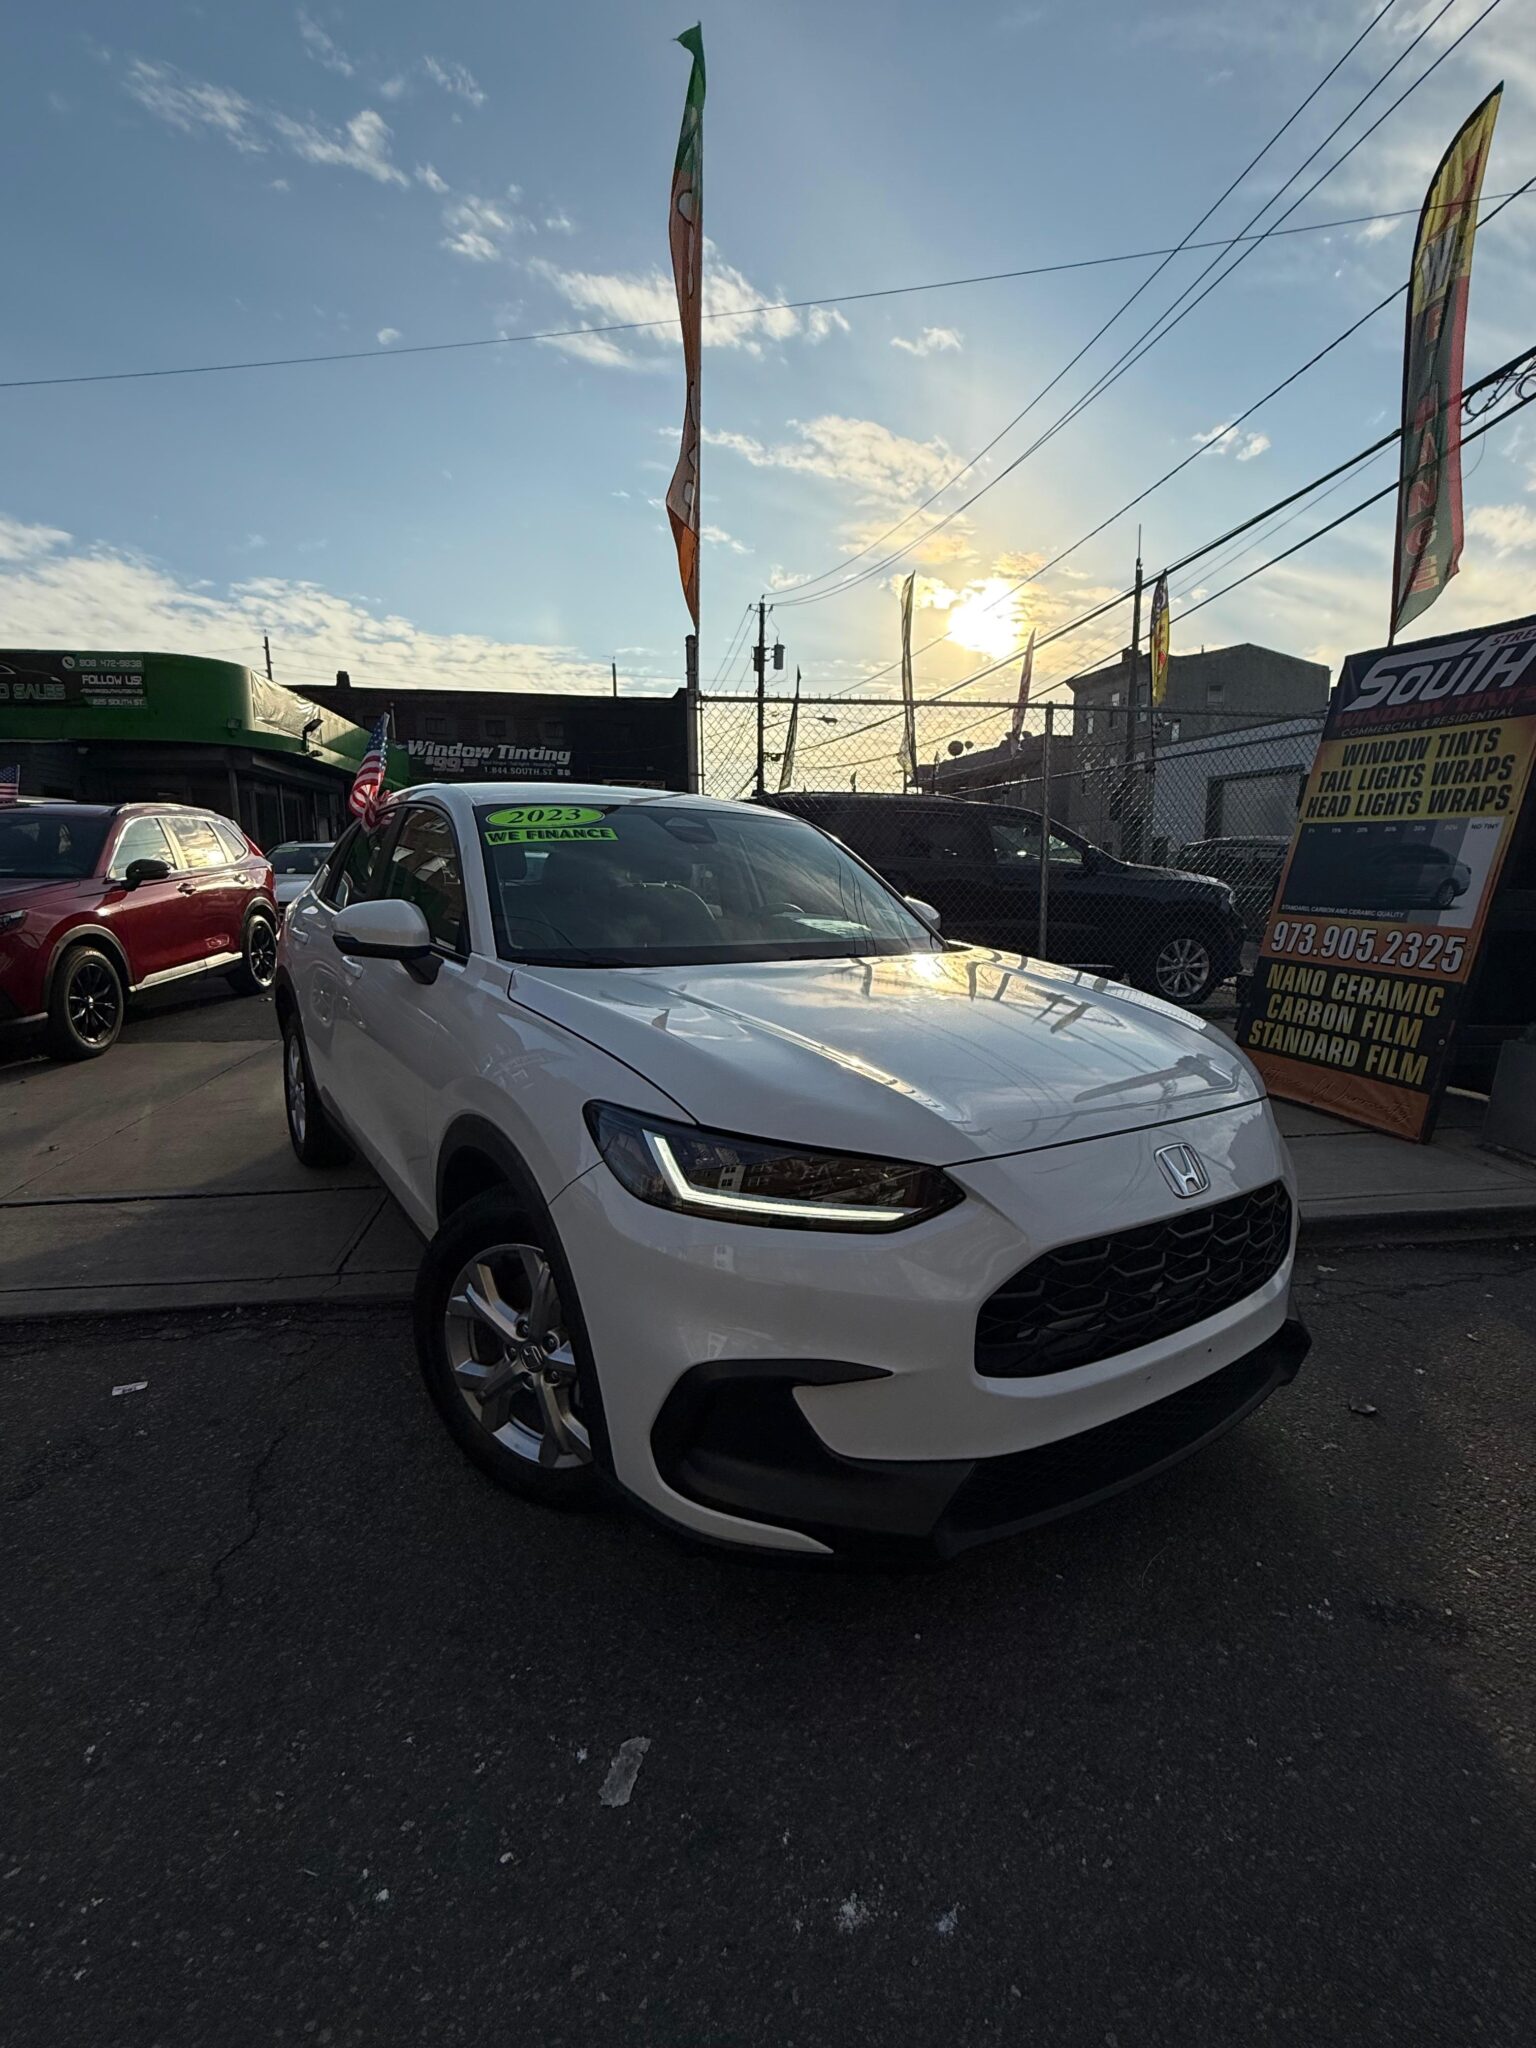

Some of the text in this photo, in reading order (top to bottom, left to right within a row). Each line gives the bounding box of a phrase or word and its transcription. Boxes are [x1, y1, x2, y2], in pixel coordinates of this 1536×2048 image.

[1406, 304, 1443, 593] FNANCE
[1490, 628, 1536, 647] STRE
[82, 675, 122, 685] FOLLOW
[1342, 626, 1536, 712] SOUTH
[13, 683, 66, 700] SALES
[108, 698, 133, 706] SOUTH
[1335, 700, 1450, 727] WINDOW
[1340, 707, 1515, 737] COMMERCIAL & RESIDENTIAL
[407, 740, 494, 759] Window
[497, 745, 572, 766] Tinting
[1341, 727, 1502, 767] WINDOW TINTS
[1318, 754, 1516, 793] TAIL LIGHTS WRAPS
[1305, 784, 1513, 819] HEAD LIGHTS WRAPS
[508, 807, 582, 825] 2023
[1484, 822, 1500, 830] TINT
[488, 827, 612, 843] WE FINANCE
[1335, 907, 1348, 915] AND
[1349, 908, 1376, 917] CERAMIC
[1376, 910, 1405, 919] QUALITY
[1271, 921, 1467, 973] 973.905.2325
[1266, 963, 1446, 1018] NANO CERAMIC
[1266, 994, 1424, 1049] CARBON FILM
[1248, 1019, 1429, 1085] STANDARD FILM
